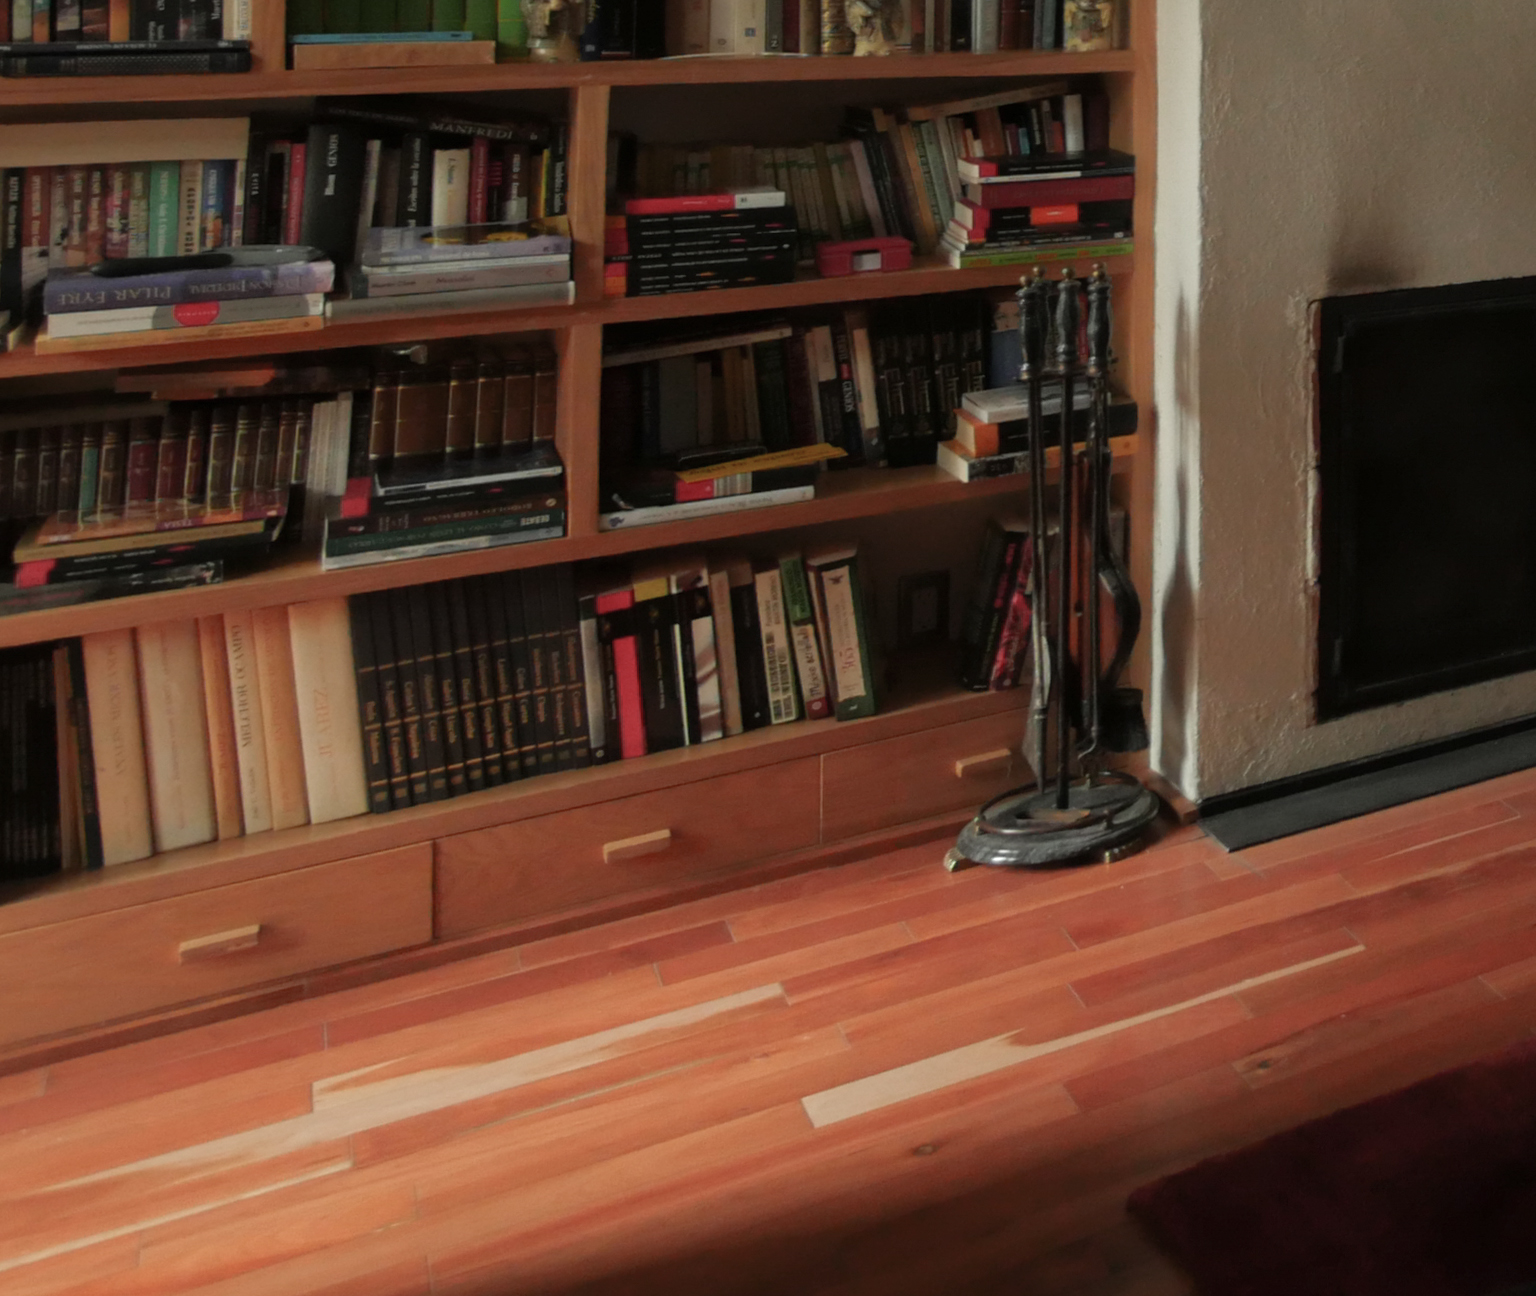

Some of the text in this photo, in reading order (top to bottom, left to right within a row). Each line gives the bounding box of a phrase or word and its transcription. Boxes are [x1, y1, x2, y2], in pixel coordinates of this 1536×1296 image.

[429, 122, 513, 140] MANFREDI
[326, 134, 339, 167] GENIOS
[57, 289, 107, 309] EYRE
[113, 285, 173, 304] PILAR
[842, 381, 855, 413] GENIOS
[232, 624, 252, 748] MELCHOR OCAMPO
